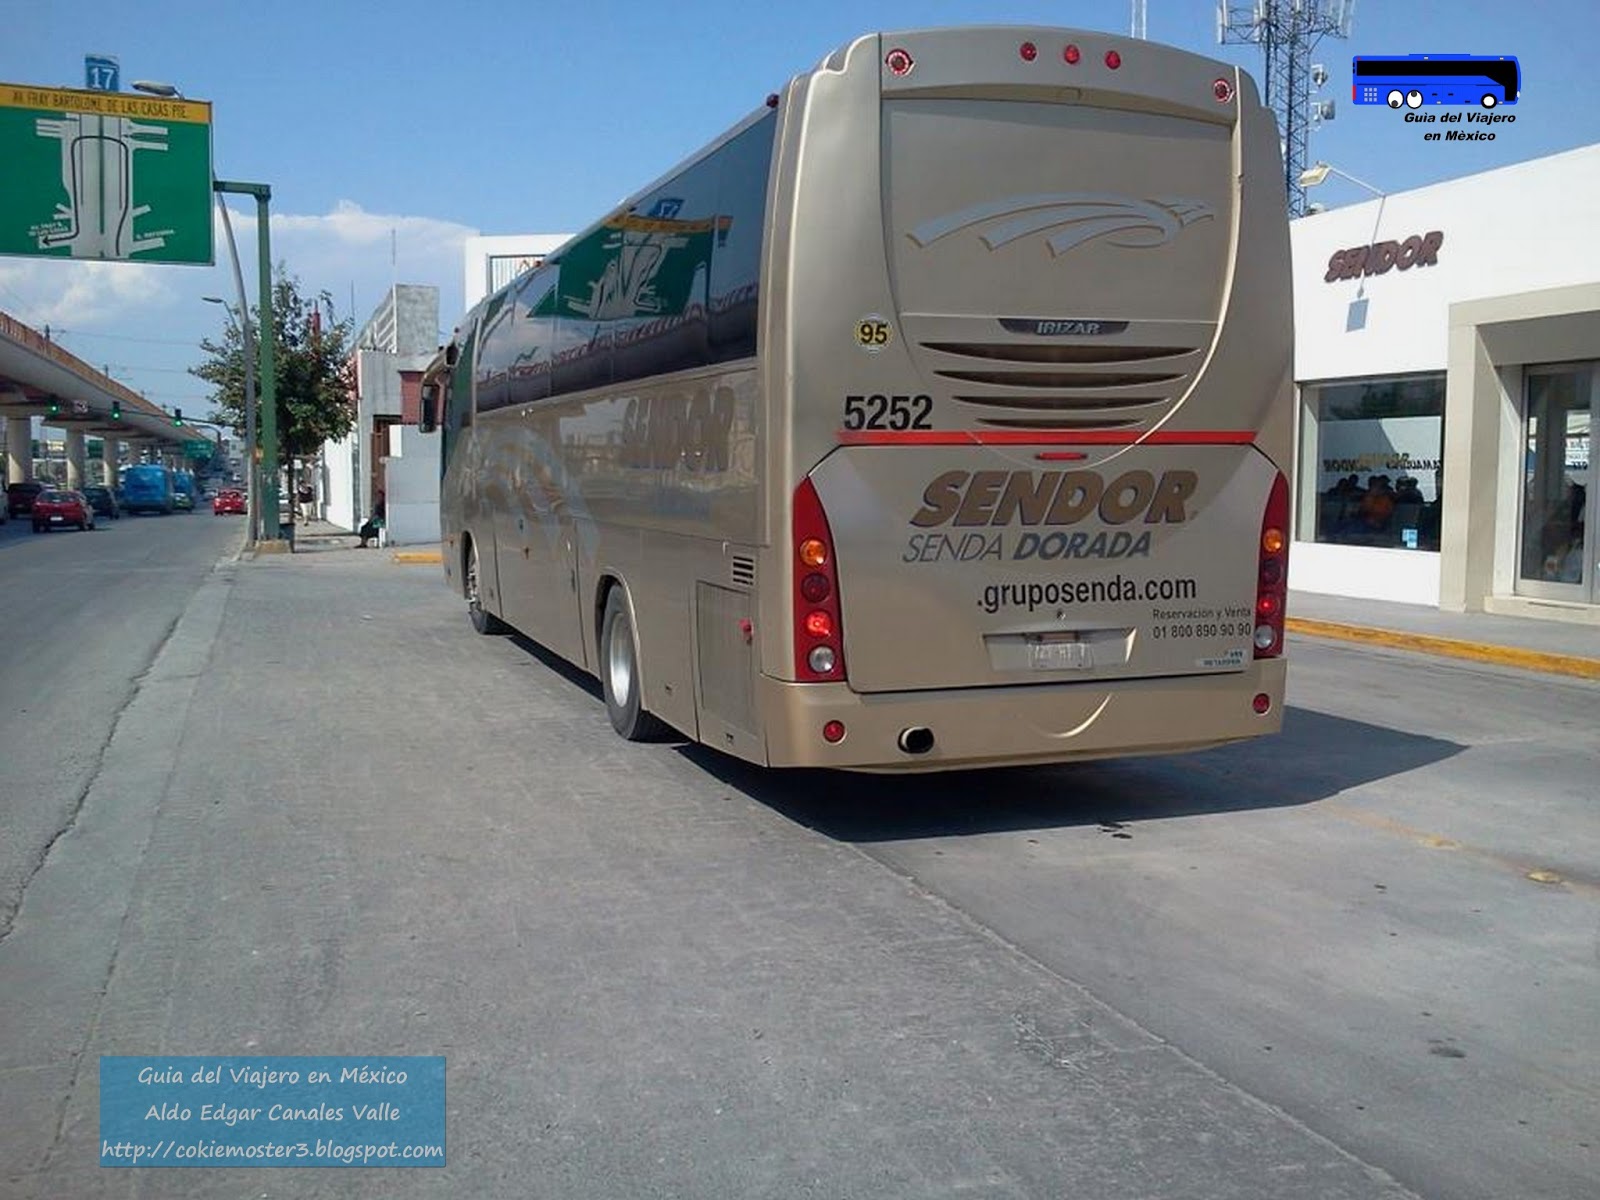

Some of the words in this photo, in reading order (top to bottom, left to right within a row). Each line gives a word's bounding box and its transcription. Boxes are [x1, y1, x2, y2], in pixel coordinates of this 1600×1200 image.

[91, 67, 115, 89] 17
[120, 100, 139, 115] LAS
[141, 102, 169, 118] CASAS
[1324, 231, 1443, 283] SENDOR
[860, 323, 888, 344] 95
[1036, 321, 1101, 334] IRIZAR
[844, 394, 933, 430] 5252
[909, 469, 1199, 528] SENDOR
[903, 532, 1003, 563] SENDA
[1013, 531, 1151, 560] DORADA
[1225, 606, 1251, 617] Venta
[1153, 626, 1166, 638] 01
[1171, 624, 1193, 638] 800
[1196, 624, 1217, 637] 890
[1220, 624, 1234, 636] 90
[1238, 622, 1252, 636] 90
